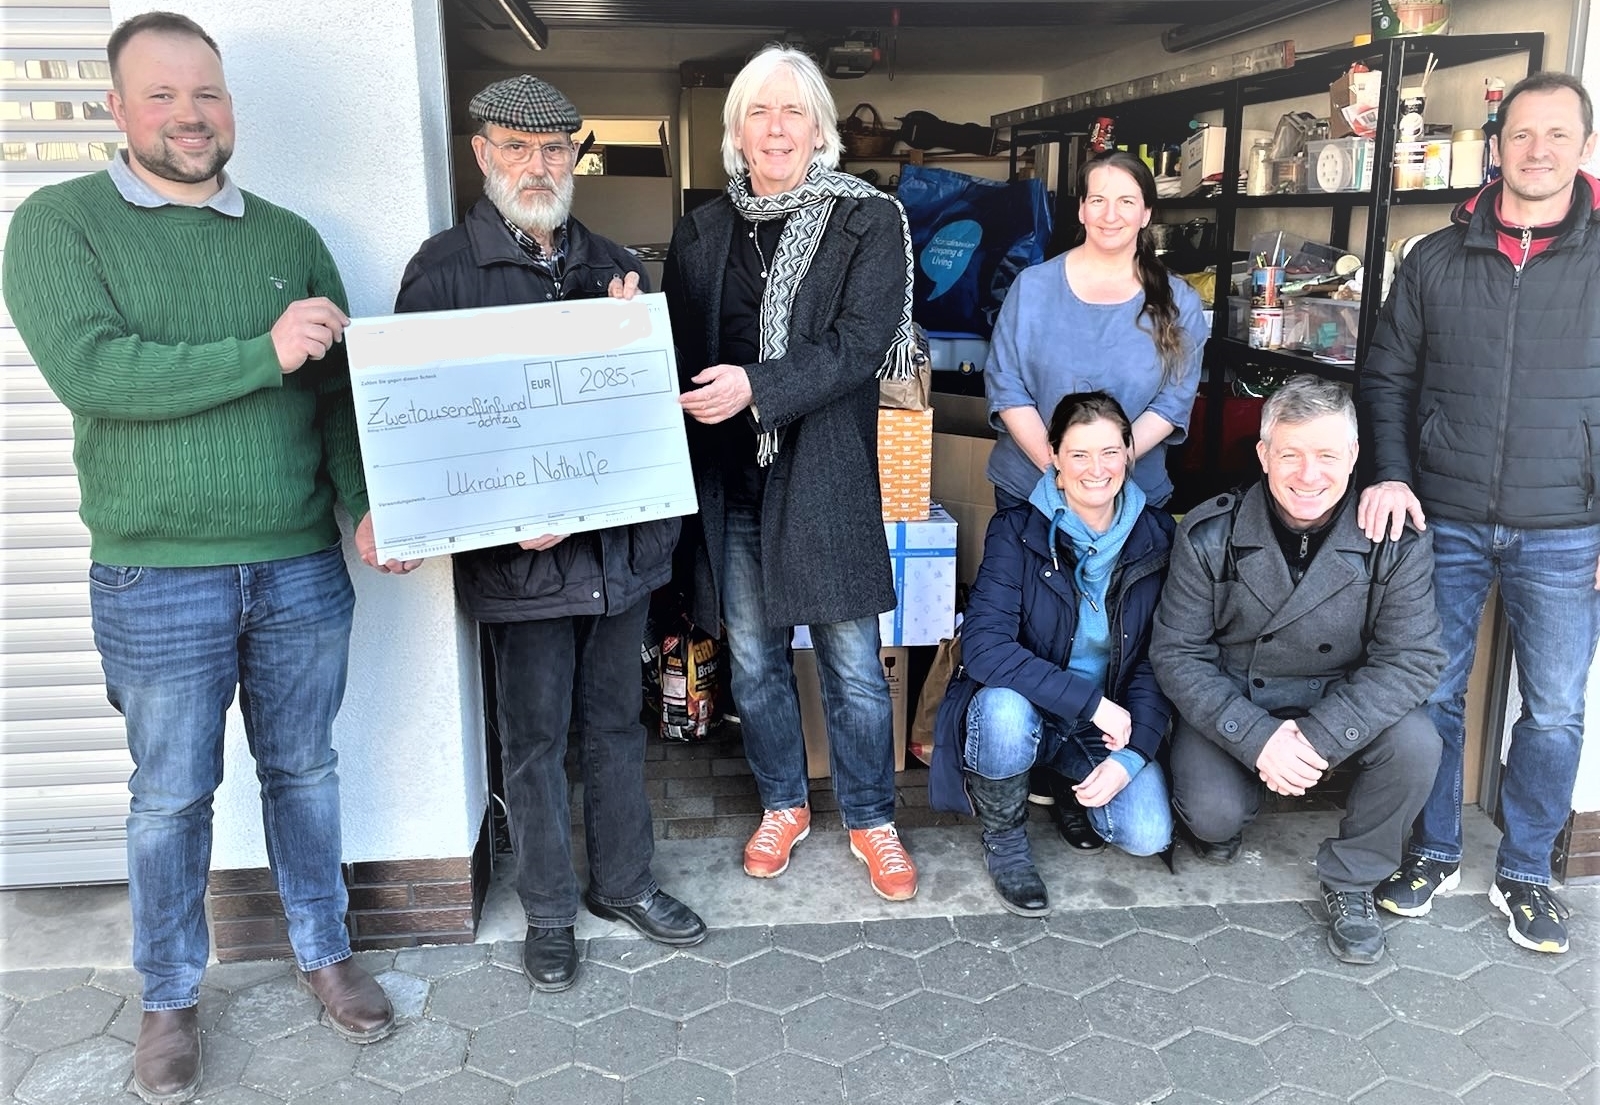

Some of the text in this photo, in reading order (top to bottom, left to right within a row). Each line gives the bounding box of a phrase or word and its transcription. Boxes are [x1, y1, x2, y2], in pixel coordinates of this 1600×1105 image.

[932, 255, 952, 269] Living
[531, 378, 551, 390] EUR
[446, 451, 609, 496] Ukraine Nothilfe
